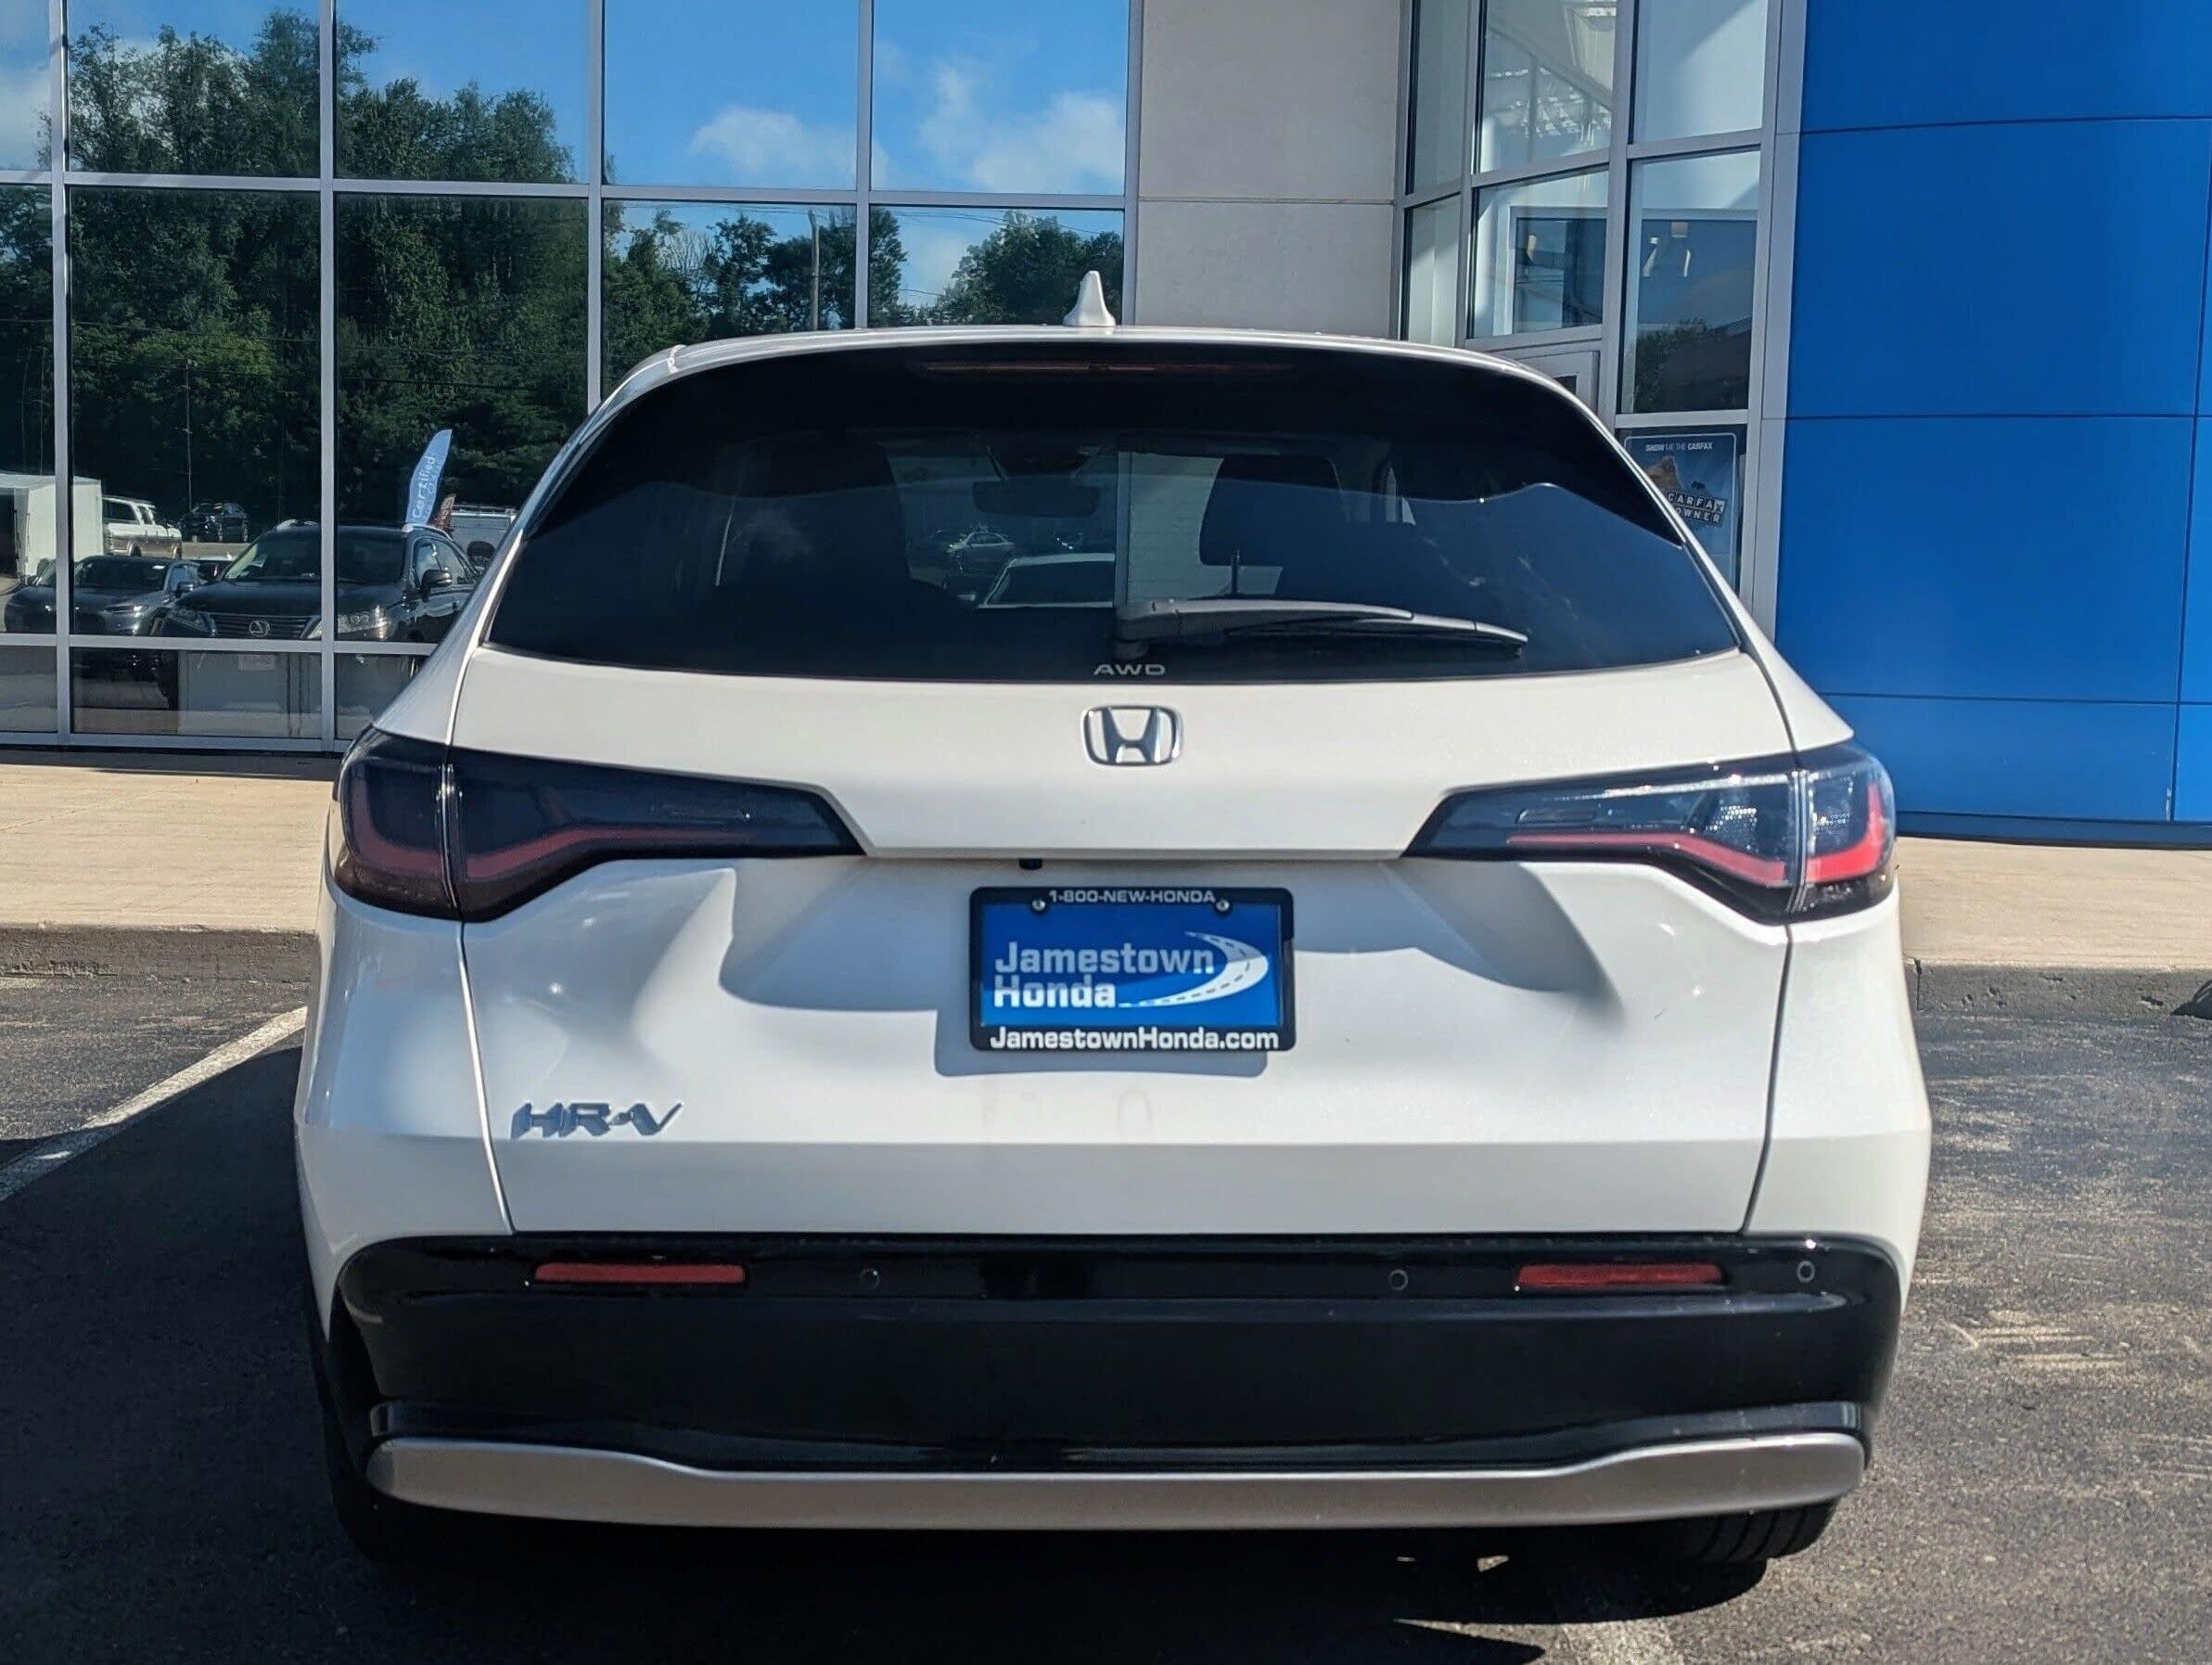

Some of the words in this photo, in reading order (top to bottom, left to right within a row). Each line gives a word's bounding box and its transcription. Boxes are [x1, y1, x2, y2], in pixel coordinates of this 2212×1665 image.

[1687, 442, 1713, 451] CARFAX
[412, 456, 436, 519] Certified
[1668, 492, 1725, 513] CARFAX
[1093, 663, 1166, 676] AWD
[1049, 890, 1216, 904] 1-800-NEW-HONDA
[994, 941, 1214, 975] Jamestown
[992, 974, 1117, 1008] Honda
[989, 1026, 1280, 1051] JamestownHonda.com
[510, 1101, 684, 1140] HR-V
